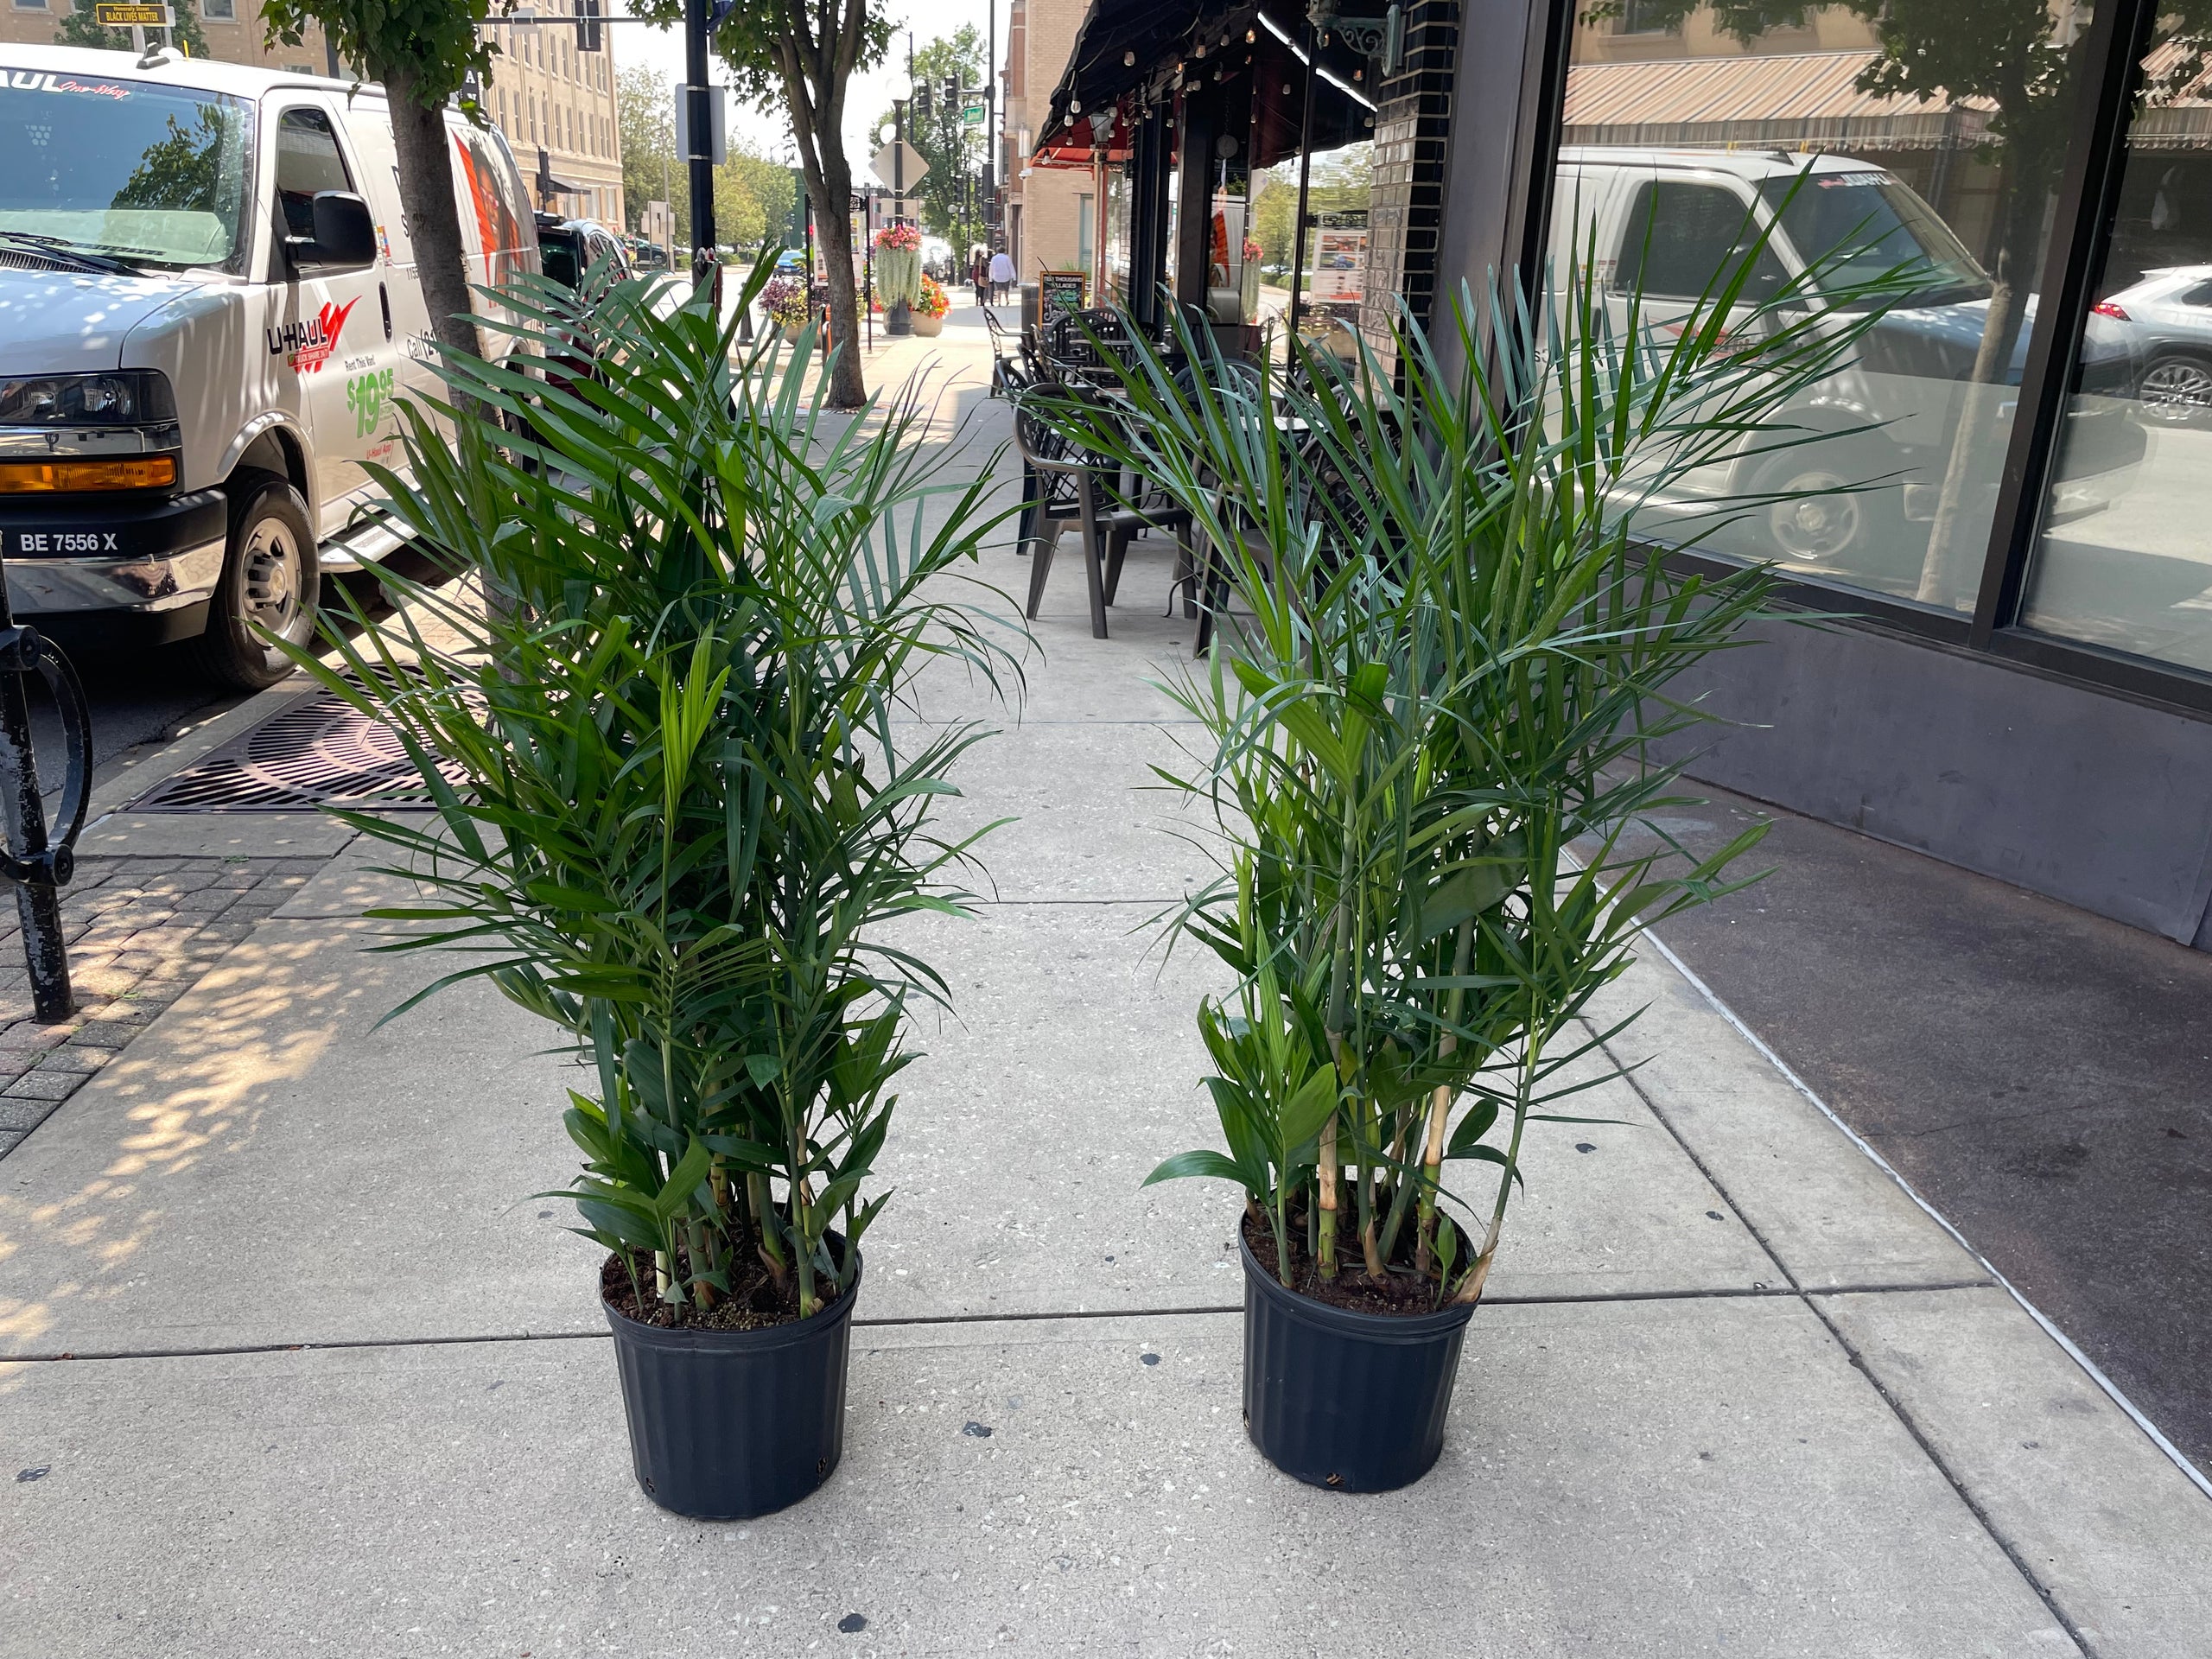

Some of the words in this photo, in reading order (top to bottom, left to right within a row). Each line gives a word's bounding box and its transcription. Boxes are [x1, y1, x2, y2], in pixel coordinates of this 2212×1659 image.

[105, 12, 123, 21] BLACK
[124, 12, 137, 21] LIVES
[138, 12, 158, 21] MATTER
[266, 318, 327, 355] U-HAUL
[407, 336, 423, 359] Call
[355, 356, 366, 369] This
[20, 533, 49, 551] BE
[53, 533, 99, 551] 7556
[103, 532, 118, 550] X
